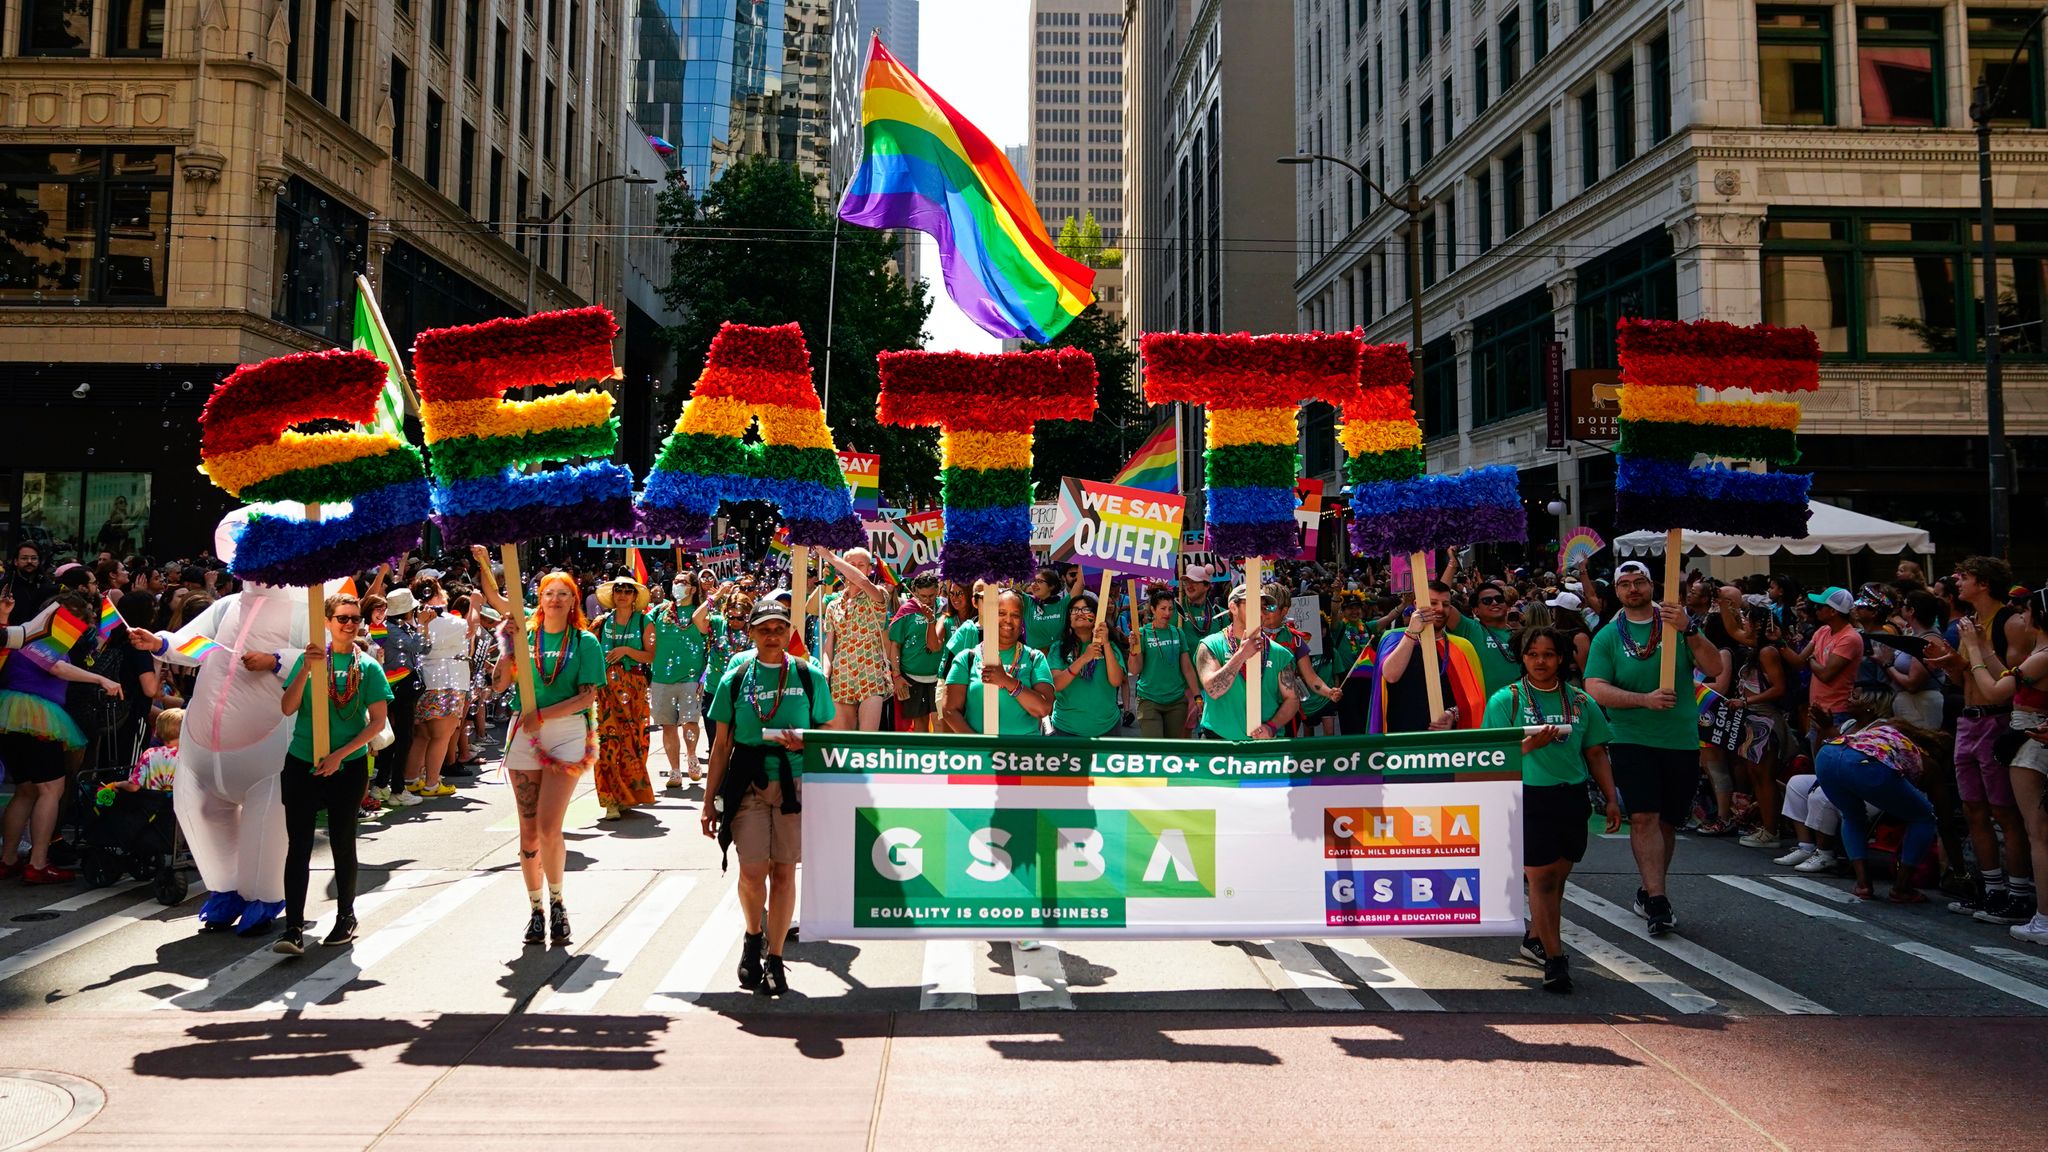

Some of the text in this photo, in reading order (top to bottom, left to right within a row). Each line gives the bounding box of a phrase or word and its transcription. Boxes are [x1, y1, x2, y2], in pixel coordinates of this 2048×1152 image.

[1578, 416, 1619, 424] BOUR
[1081, 490, 1180, 523] WE SAY
[908, 519, 939, 535] WE
[1074, 517, 1173, 569] QUEER
[1711, 702, 1728, 745] BE GAY
[821, 747, 1506, 775] Washington State's LGBTQ+ Chamber of Commerce
[1333, 814, 1472, 839] CHBA
[871, 827, 1199, 882] GSBA
[1332, 877, 1473, 903] GSBA
[870, 907, 1109, 918] EQUALITY IS GOOD BUSINESS
[1330, 914, 1391, 922] SCHOLARSHIP
[1401, 913, 1451, 921] EDUCATION
